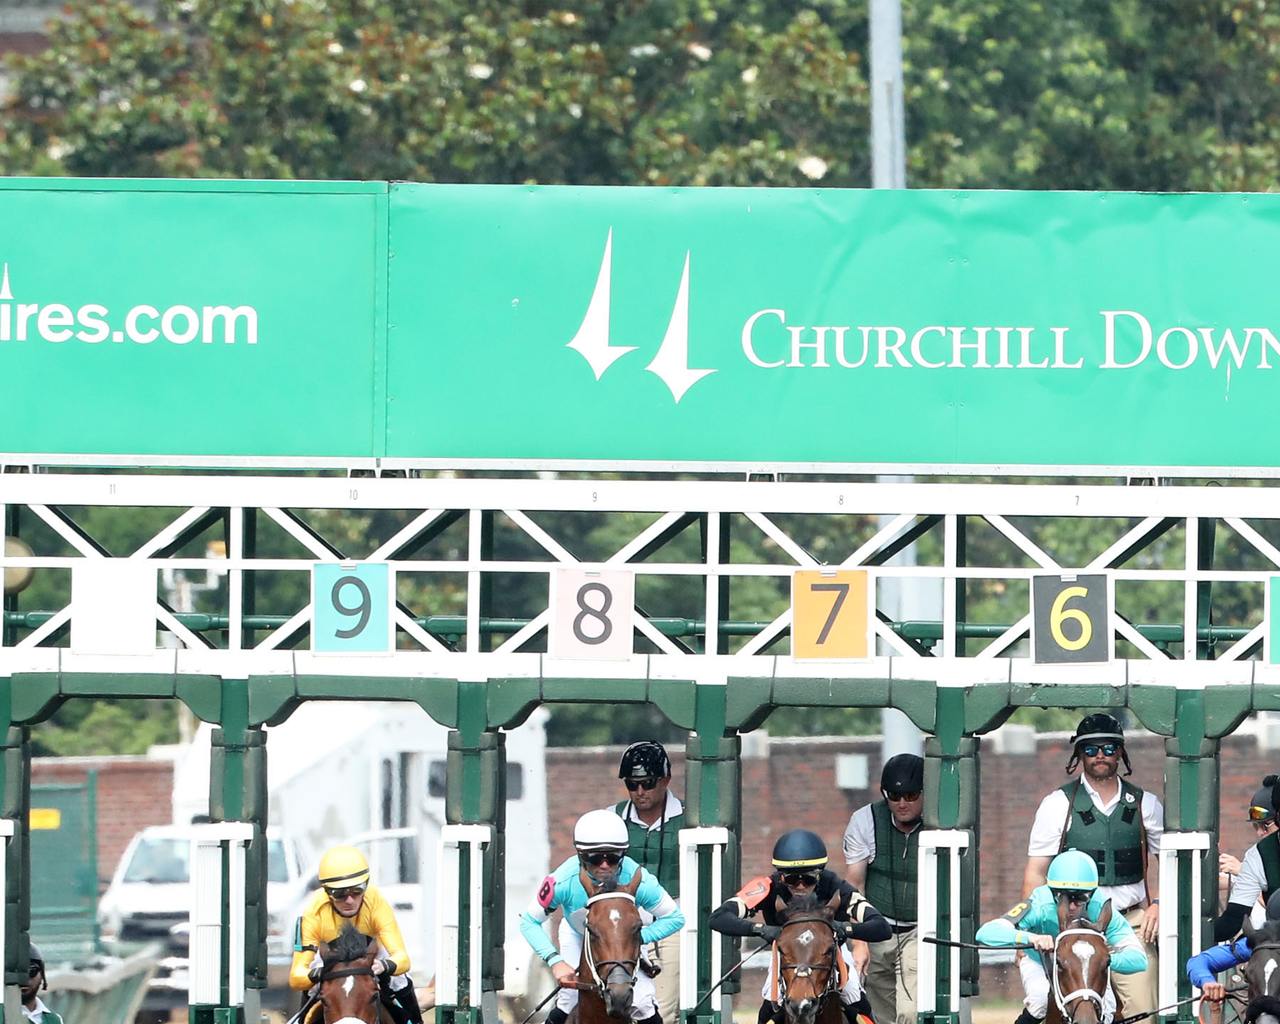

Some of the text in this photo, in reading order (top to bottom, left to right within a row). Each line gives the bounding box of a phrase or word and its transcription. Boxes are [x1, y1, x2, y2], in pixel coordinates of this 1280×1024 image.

[331, 575, 371, 639] 9
[573, 582, 613, 645] 8
[811, 583, 850, 645] 7
[1050, 587, 1092, 651] 6
[1007, 902, 1028, 918] 6
